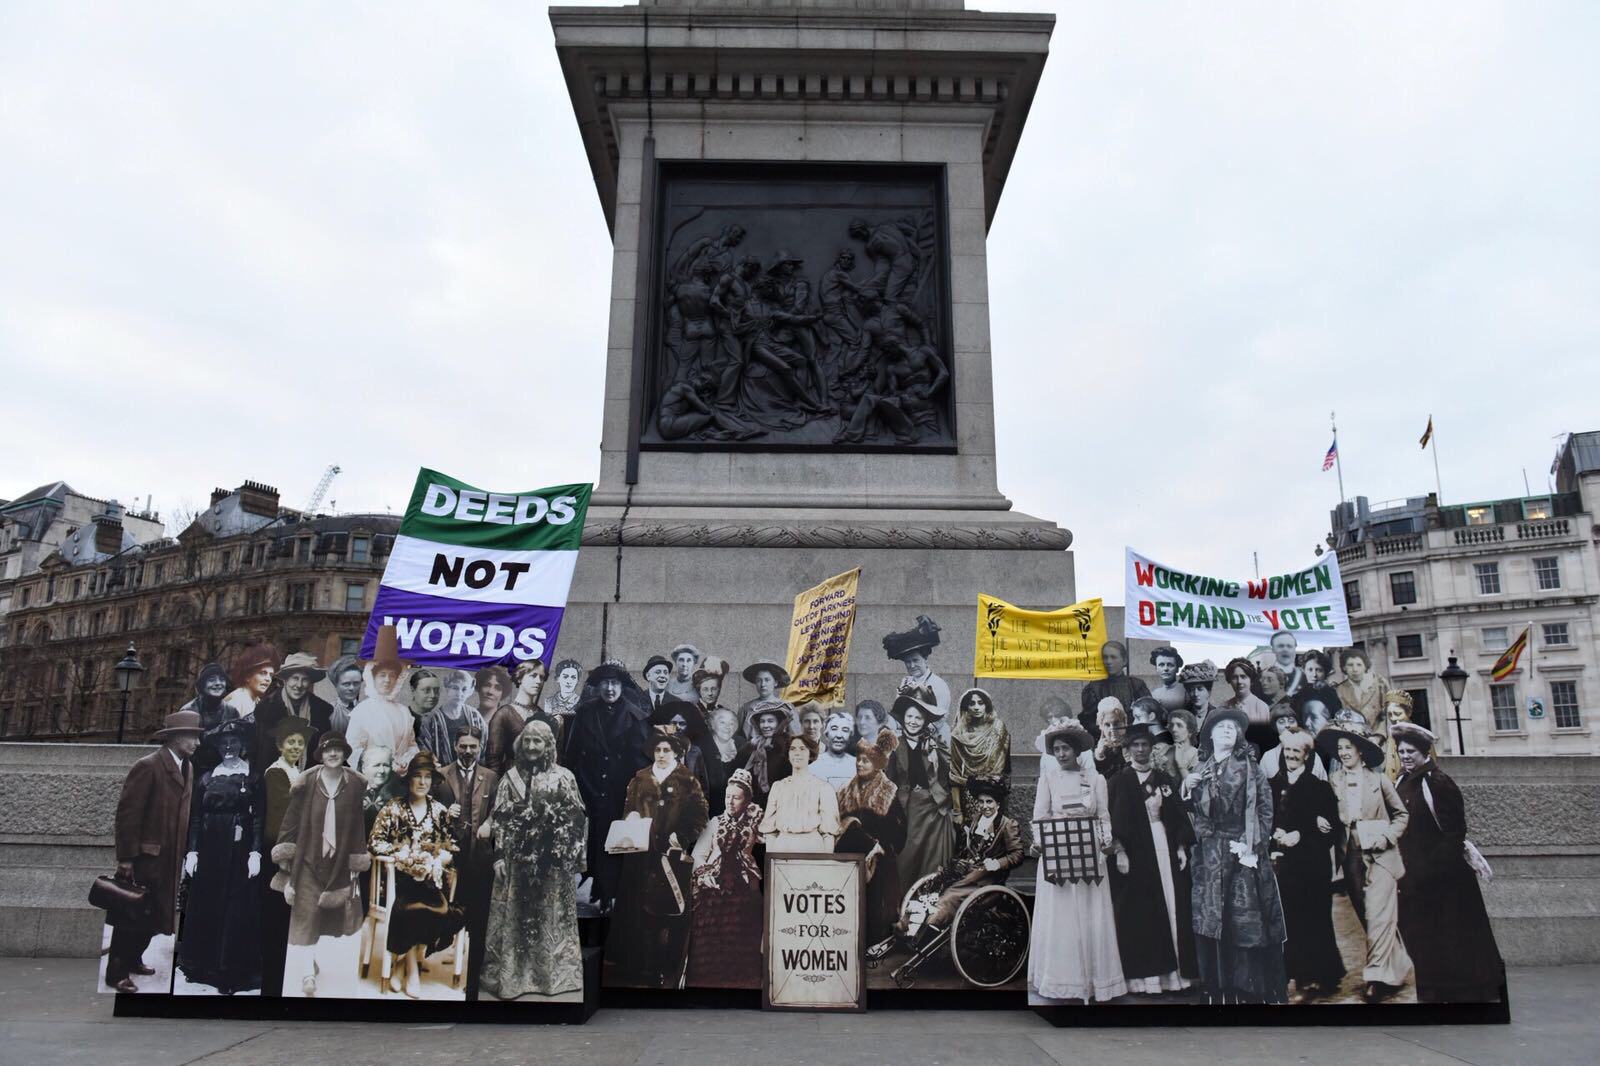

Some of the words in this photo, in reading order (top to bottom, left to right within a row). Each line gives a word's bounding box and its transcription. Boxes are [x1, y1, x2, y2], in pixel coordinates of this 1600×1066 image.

[421, 483, 577, 525] DEEDS
[428, 553, 530, 591] NOT
[1134, 561, 1240, 598] WORKING
[1247, 565, 1333, 600] WOMEN
[794, 614, 809, 627] OUT
[1138, 600, 1246, 630] DEMAND
[1246, 614, 1264, 624] THE
[1262, 605, 1335, 631] VOTE
[383, 616, 547, 661] WORDS
[1048, 621, 1073, 635] BILL
[1017, 639, 1061, 652] WHOLE
[783, 893, 846, 914] VOTES
[798, 924, 831, 938] FOR
[781, 949, 848, 971] WOMEN
